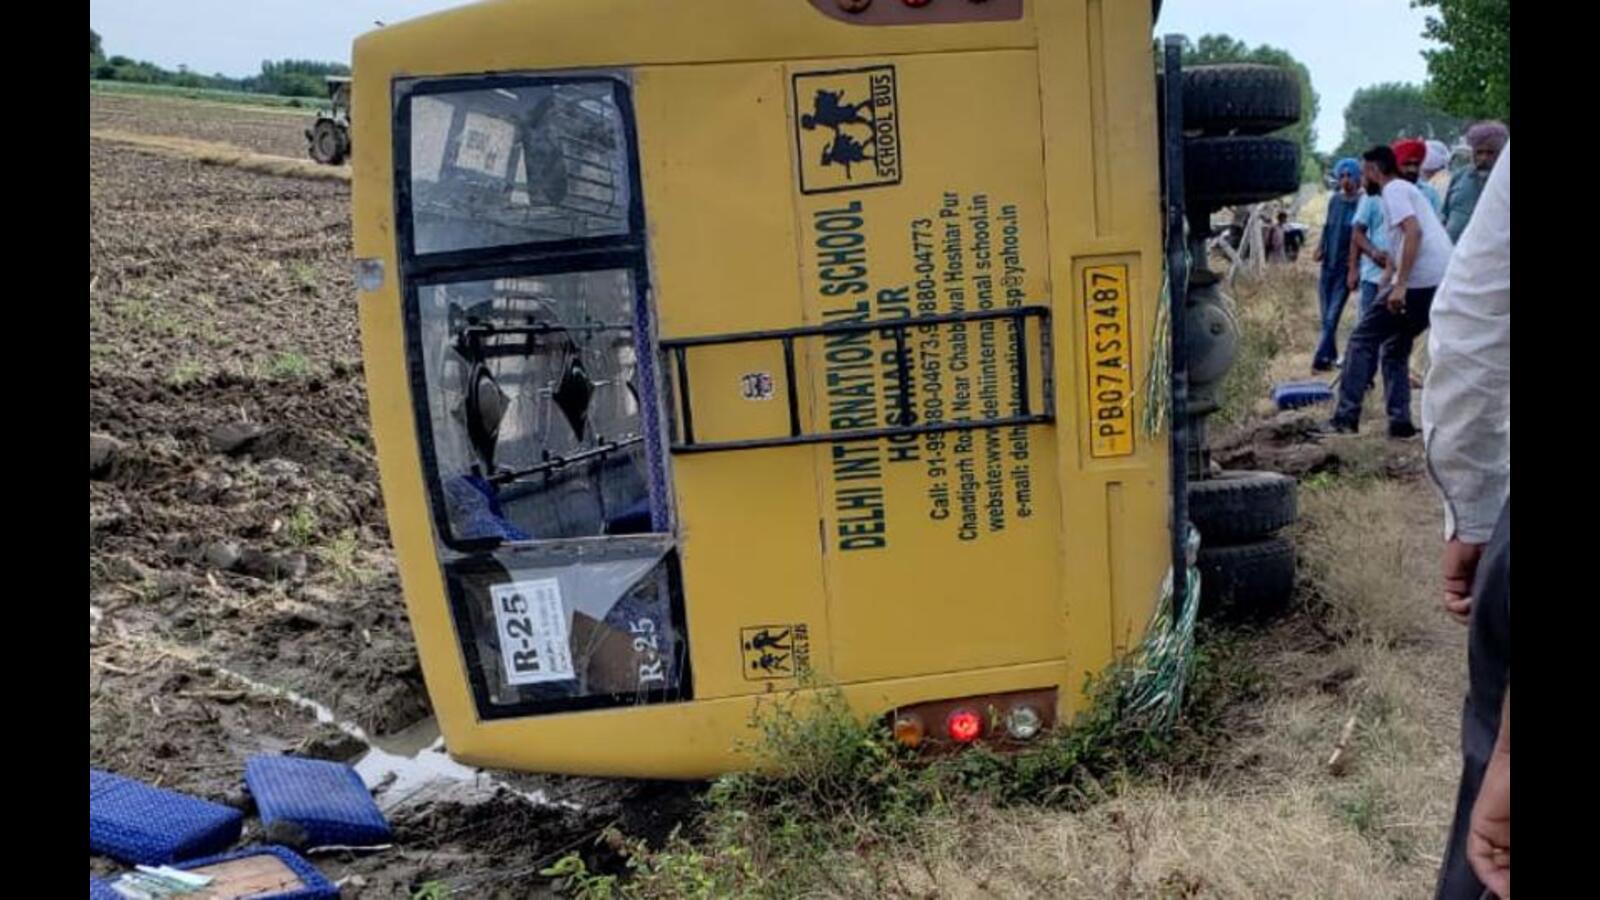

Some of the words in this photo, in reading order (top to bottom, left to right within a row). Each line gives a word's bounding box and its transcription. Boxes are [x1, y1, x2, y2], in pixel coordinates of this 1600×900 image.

[874, 74, 892, 107] BUS
[877, 112, 895, 177] SCHOOL
[939, 191, 960, 218] Pur
[967, 194, 992, 269] school.in
[813, 201, 868, 296] SCHOOL
[943, 222, 964, 282] Hoshiar
[912, 217, 947, 478] 91-9980-04673,9880-04773
[948, 287, 968, 372] Chabbwal
[1092, 273, 1124, 437] PB07AS3487
[822, 301, 882, 481] INTRNATIONAL
[951, 376, 971, 412] Near
[834, 486, 887, 551] DELHI
[929, 482, 950, 521] Call:
[954, 458, 980, 541] Chandigarh
[1011, 464, 1032, 518] e-mail:
[501, 593, 540, 673] R-25
[630, 617, 665, 684] R-25
